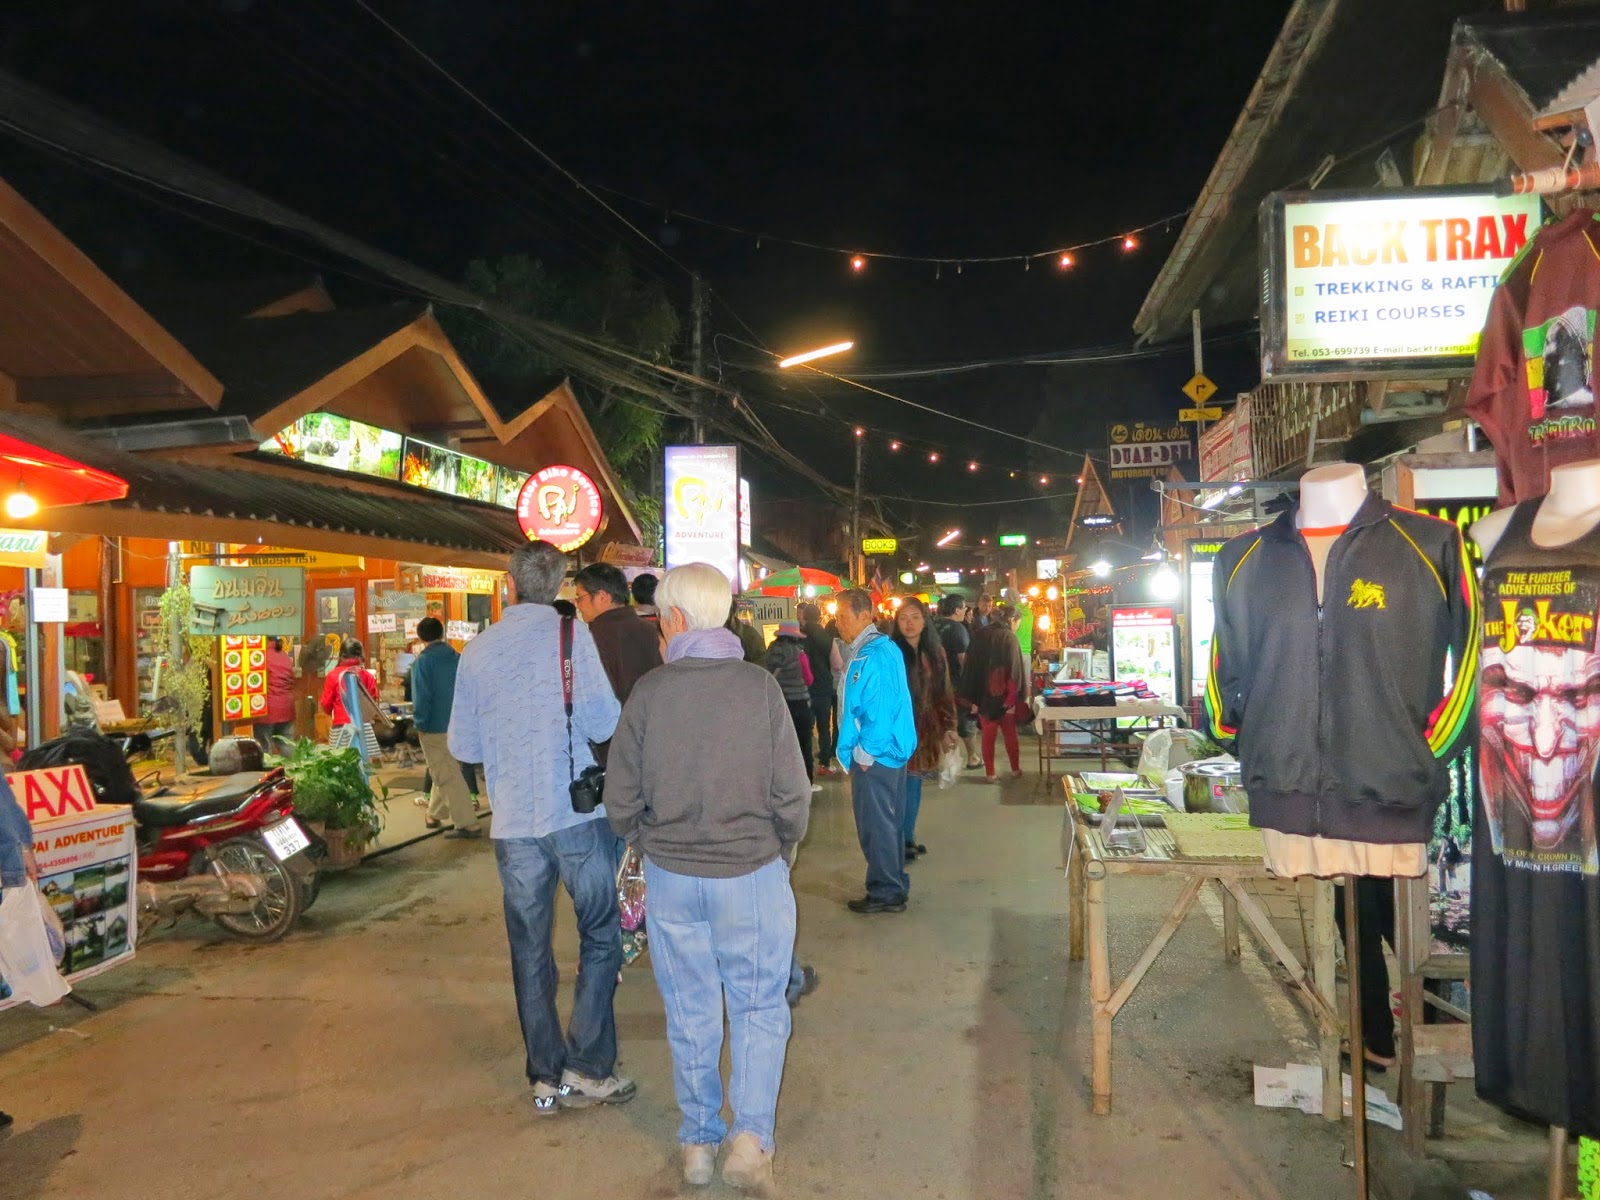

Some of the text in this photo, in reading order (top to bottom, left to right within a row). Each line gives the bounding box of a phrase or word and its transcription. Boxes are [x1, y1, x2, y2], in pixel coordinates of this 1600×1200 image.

[1293, 213, 1528, 269] BACK TRAX
[1315, 274, 1498, 296] TREKKING & RAFTI
[1314, 304, 1466, 324] REIKI COURSES
[1292, 348, 1310, 358] Tel.
[1312, 346, 1370, 357] 053-699739
[518, 467, 599, 518] Motor Bike Service
[0, 534, 39, 551] ant
[864, 539, 895, 550] BOOKS
[1507, 570, 1571, 584] THE FURTHER
[1498, 582, 1577, 595] ADVENTURES OF
[1484, 620, 1505, 637] THE
[9, 767, 95, 821] AXI
[54, 824, 125, 849] ADVENTURE
